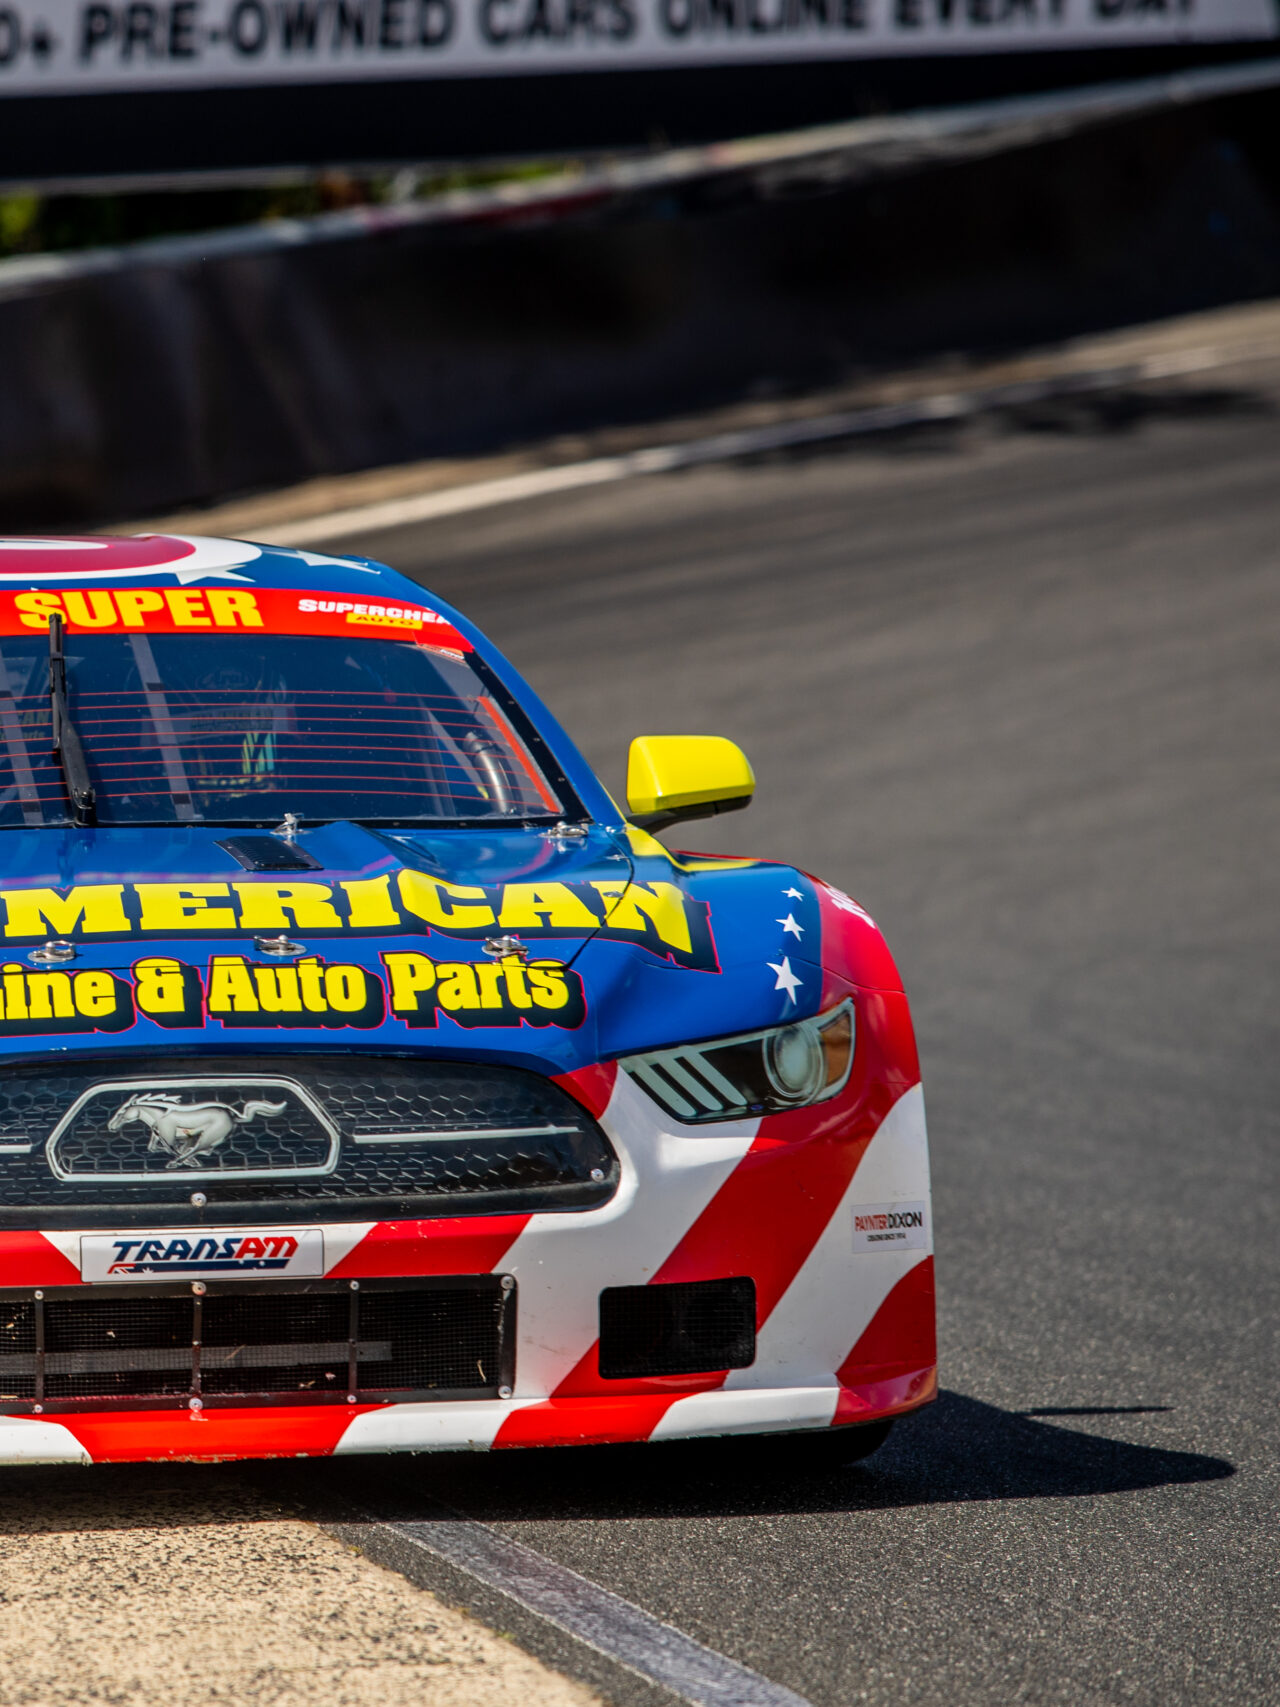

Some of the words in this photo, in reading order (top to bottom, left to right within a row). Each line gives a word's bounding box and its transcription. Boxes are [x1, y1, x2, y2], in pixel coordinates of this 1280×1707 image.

[15, 590, 264, 628] SUPER
[355, 615, 414, 626] AUTO
[135, 958, 185, 1013] &
[208, 956, 367, 1012] Auto
[387, 953, 569, 1011] Parts
